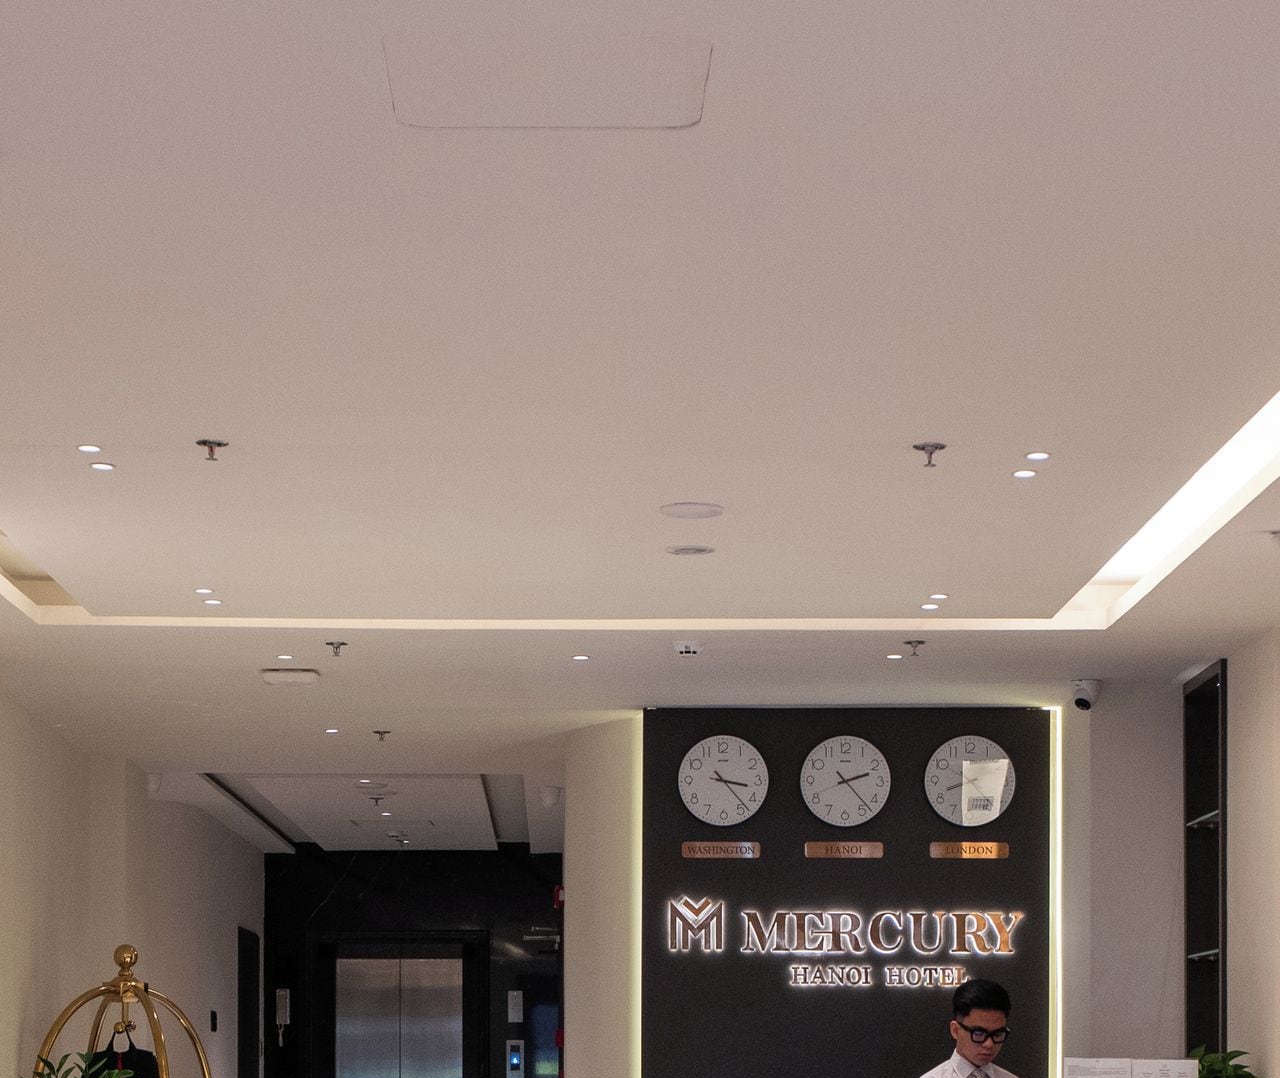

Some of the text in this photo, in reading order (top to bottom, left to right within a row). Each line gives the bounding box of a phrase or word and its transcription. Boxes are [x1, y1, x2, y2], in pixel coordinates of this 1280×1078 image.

[702, 746, 711, 758] 11
[718, 741, 729, 753] 12
[824, 746, 833, 758] 11
[840, 742, 851, 754] 12
[949, 746, 958, 758] 11
[965, 742, 976, 754] 12
[689, 758, 702, 770] 10
[748, 758, 758, 770] 2
[811, 759, 825, 770] 10
[870, 759, 880, 771] 2
[935, 759, 949, 770] 10
[684, 775, 693, 786] 9
[753, 774, 763, 786] 3
[806, 775, 815, 787] 9
[875, 775, 885, 787] 3
[930, 775, 939, 786] 9
[690, 792, 699, 804] 8
[748, 792, 757, 802] 4
[811, 792, 820, 804] 8
[870, 793, 879, 804] 4
[936, 792, 945, 804] 8
[704, 804, 712, 815] 7
[719, 808, 728, 820] 6
[736, 803, 745, 816] 5
[824, 804, 833, 816] 7
[840, 809, 850, 820] 6
[857, 804, 867, 817] 5
[948, 804, 957, 815] 7
[687, 845, 755, 855] WASHINGTON
[825, 845, 863, 855] HANOI
[945, 846, 993, 855] LONDON
[741, 910, 1024, 954] MERCURY
[790, 965, 972, 987] HANOI HOTEL
